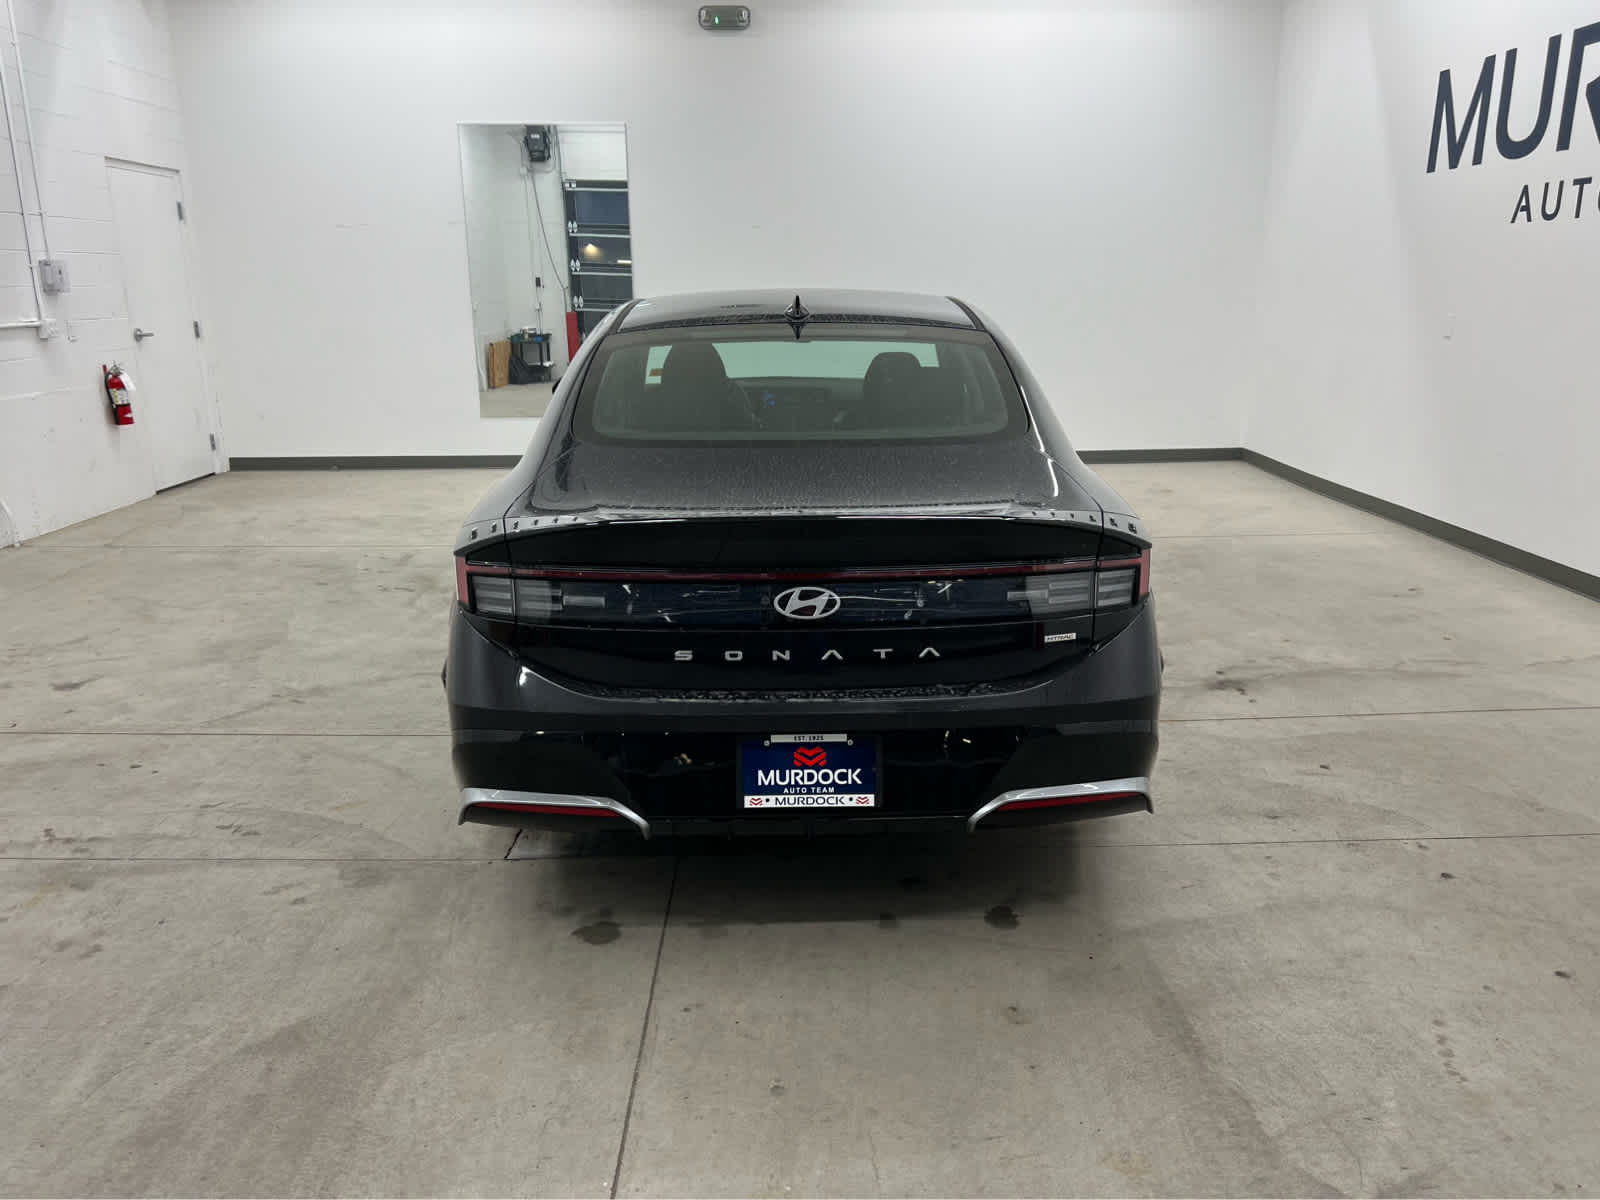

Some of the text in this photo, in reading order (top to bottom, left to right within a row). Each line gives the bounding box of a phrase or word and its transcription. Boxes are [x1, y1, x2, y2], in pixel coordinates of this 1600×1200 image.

[1510, 177, 1600, 223] AUT
[674, 647, 941, 662] SONATA
[757, 768, 862, 786] MURDOCK
[775, 796, 845, 806] MURDOCK
